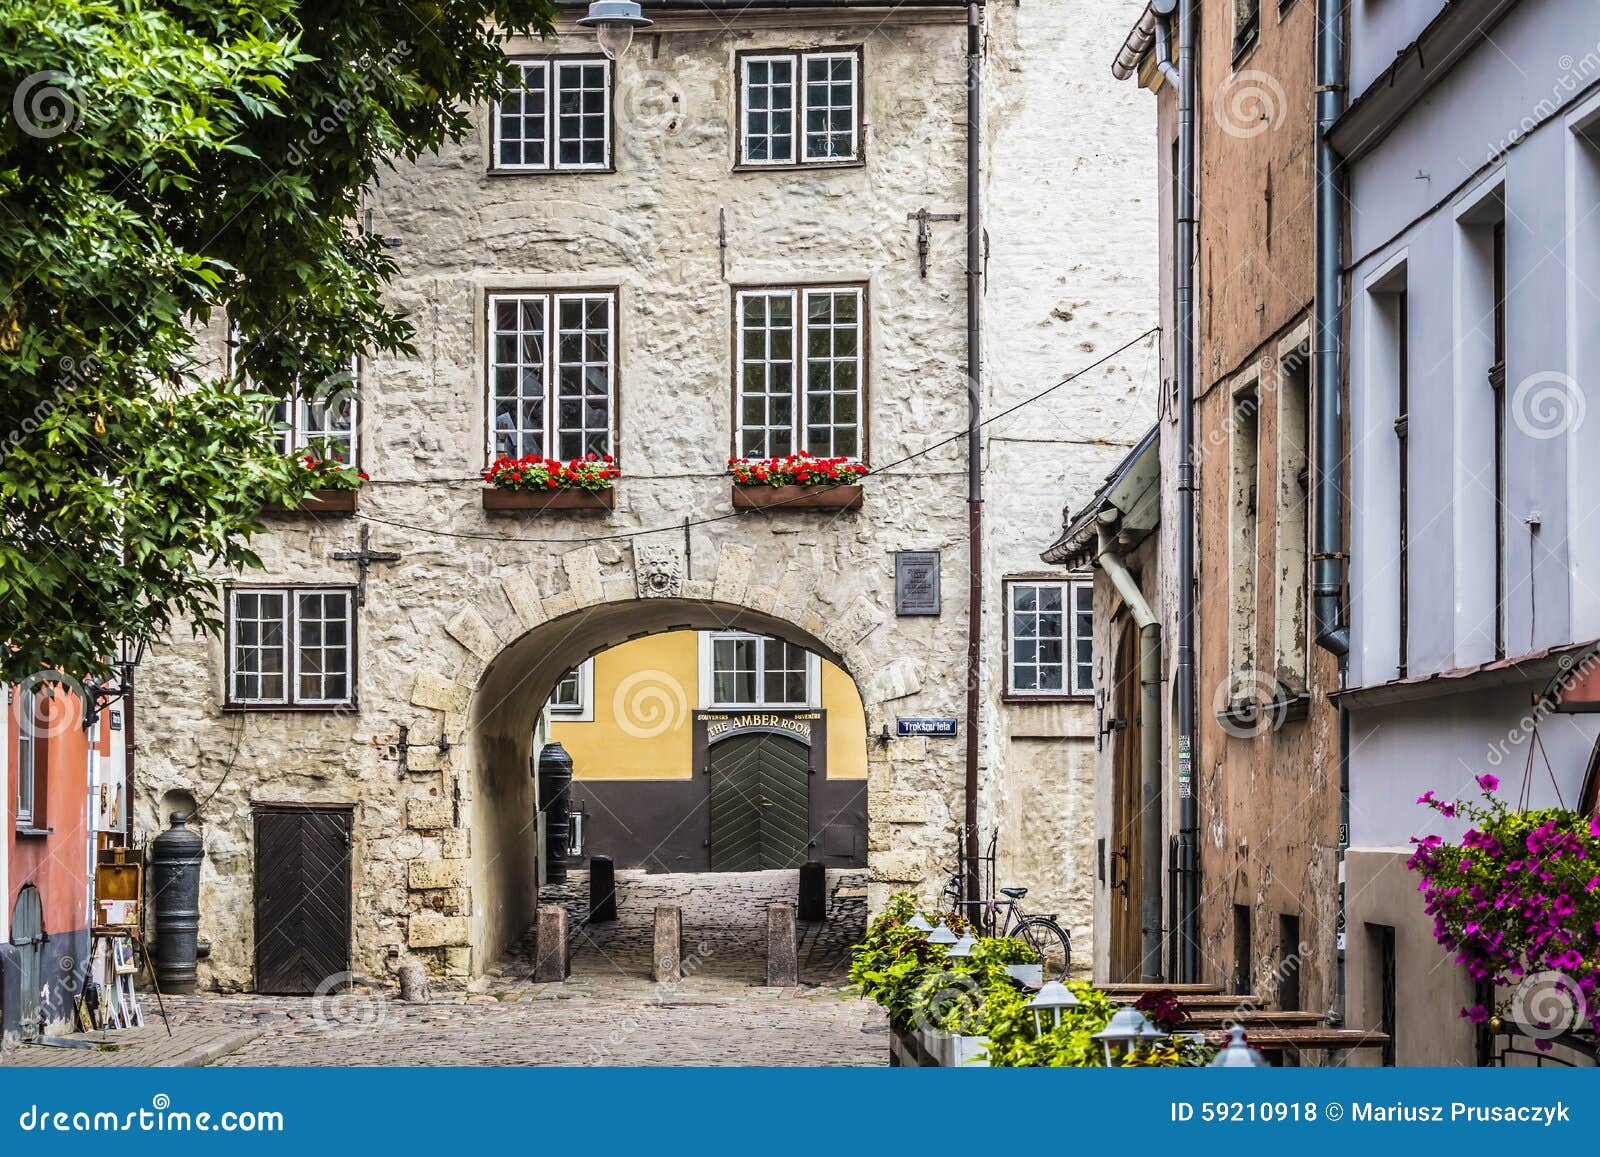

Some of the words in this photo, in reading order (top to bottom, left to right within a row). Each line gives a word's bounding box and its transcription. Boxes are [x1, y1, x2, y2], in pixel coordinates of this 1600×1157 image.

[708, 721, 728, 737] THE
[732, 714, 779, 728] AMBER
[781, 718, 810, 738] ROOM
